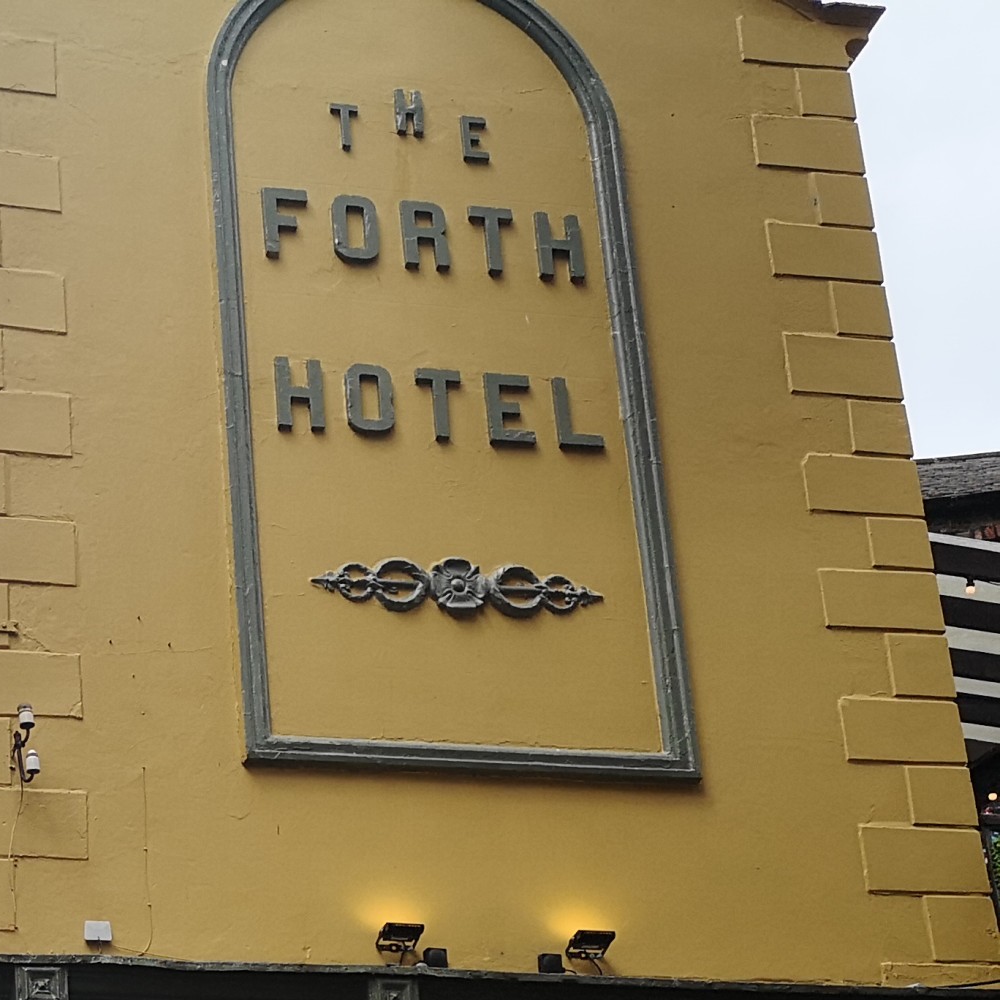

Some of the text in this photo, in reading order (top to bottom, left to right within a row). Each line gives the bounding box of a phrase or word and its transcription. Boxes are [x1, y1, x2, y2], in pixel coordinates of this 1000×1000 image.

[330, 89, 490, 164] THE
[261, 187, 587, 283] FORTH
[274, 356, 606, 450] HOTEL
